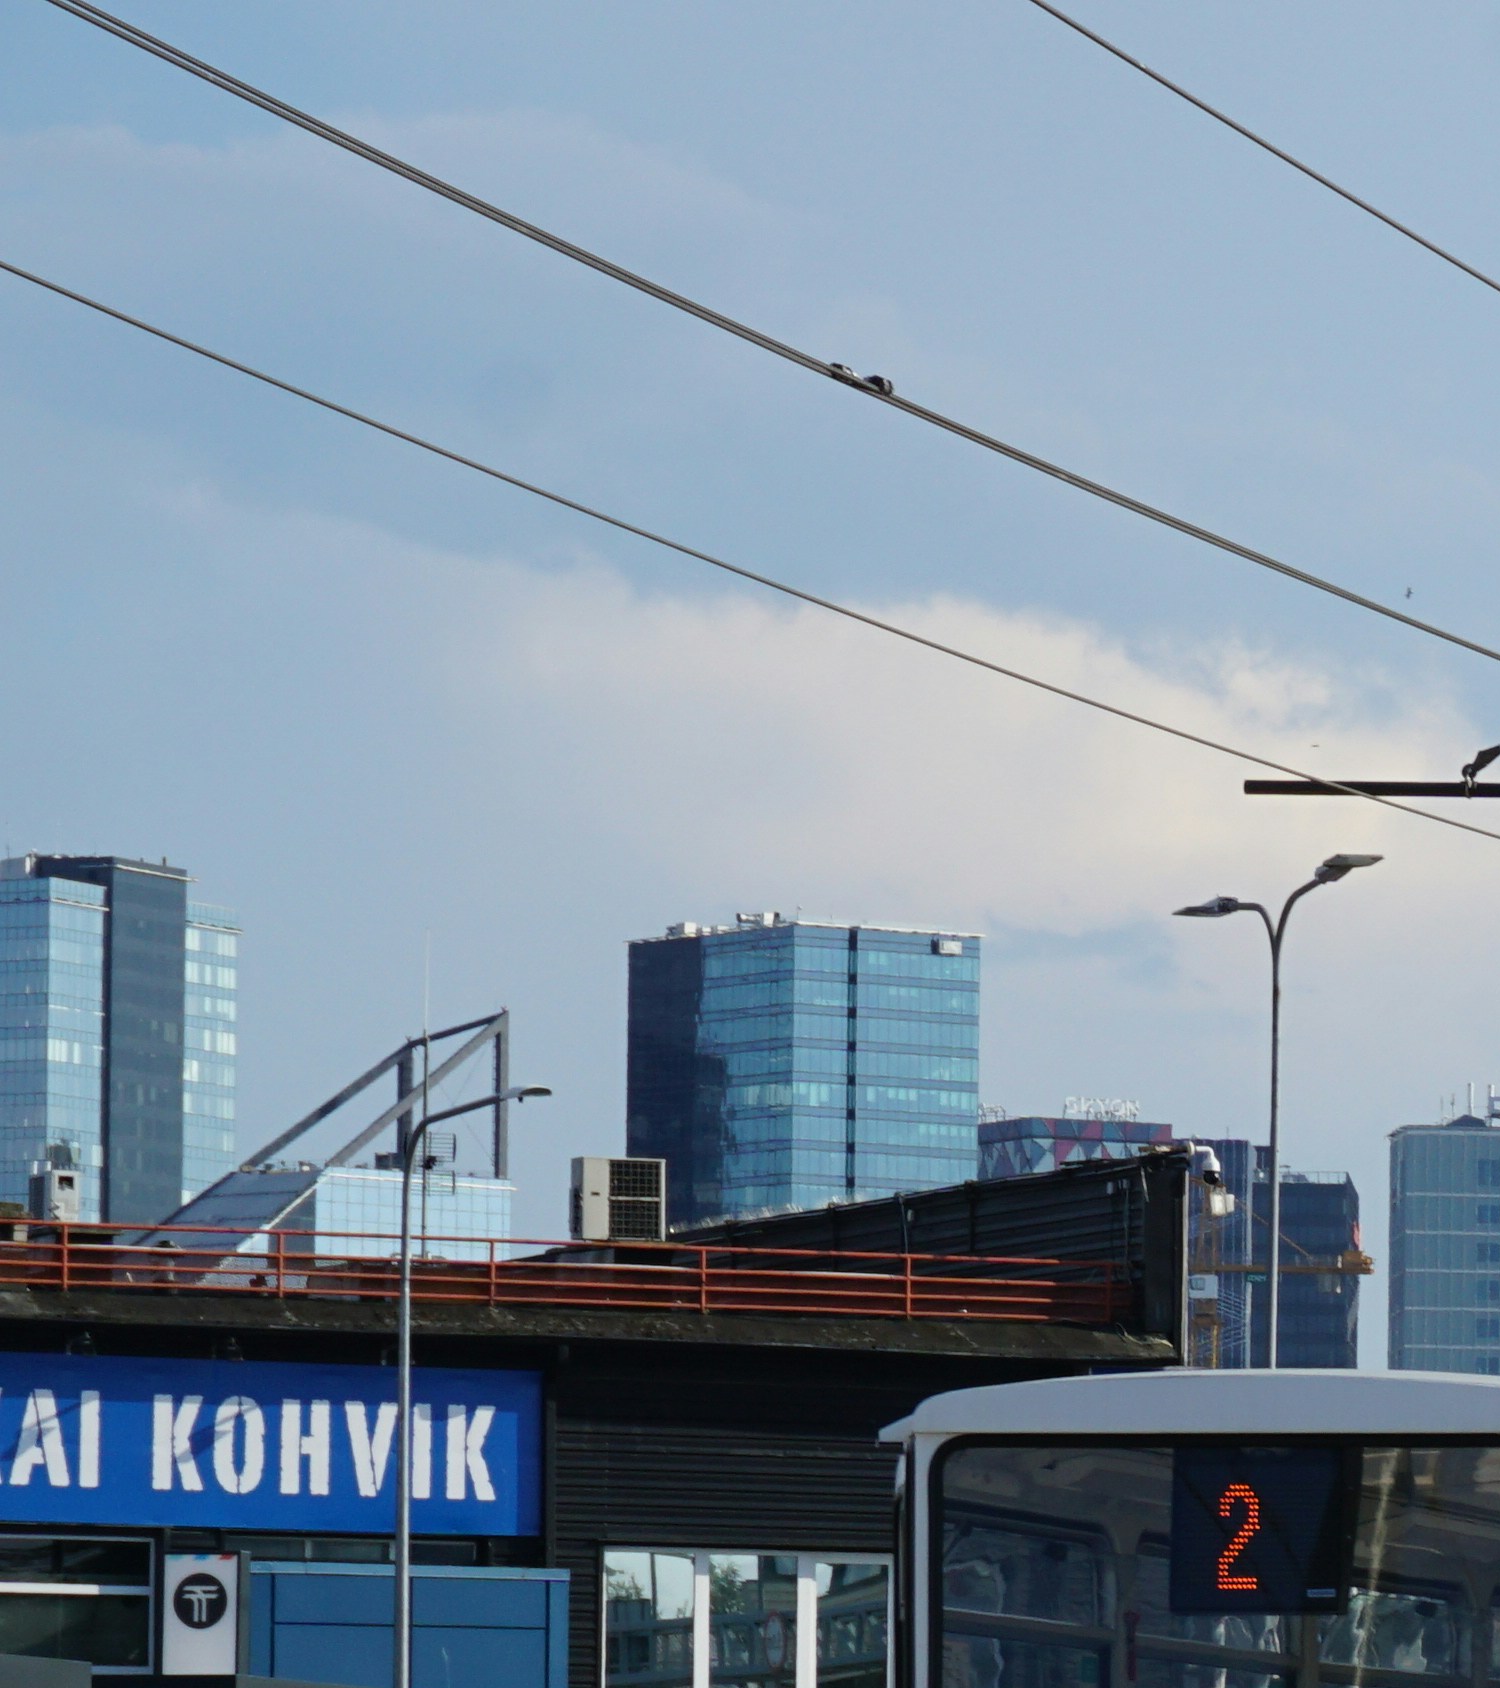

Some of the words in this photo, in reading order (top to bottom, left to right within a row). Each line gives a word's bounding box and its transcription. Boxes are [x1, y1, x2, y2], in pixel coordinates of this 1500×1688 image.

[1065, 1096, 1140, 1116] SKYON
[0, 1389, 99, 1488] AI
[152, 1394, 496, 1501] KOHVIK
[1218, 1484, 1260, 1590] 2
